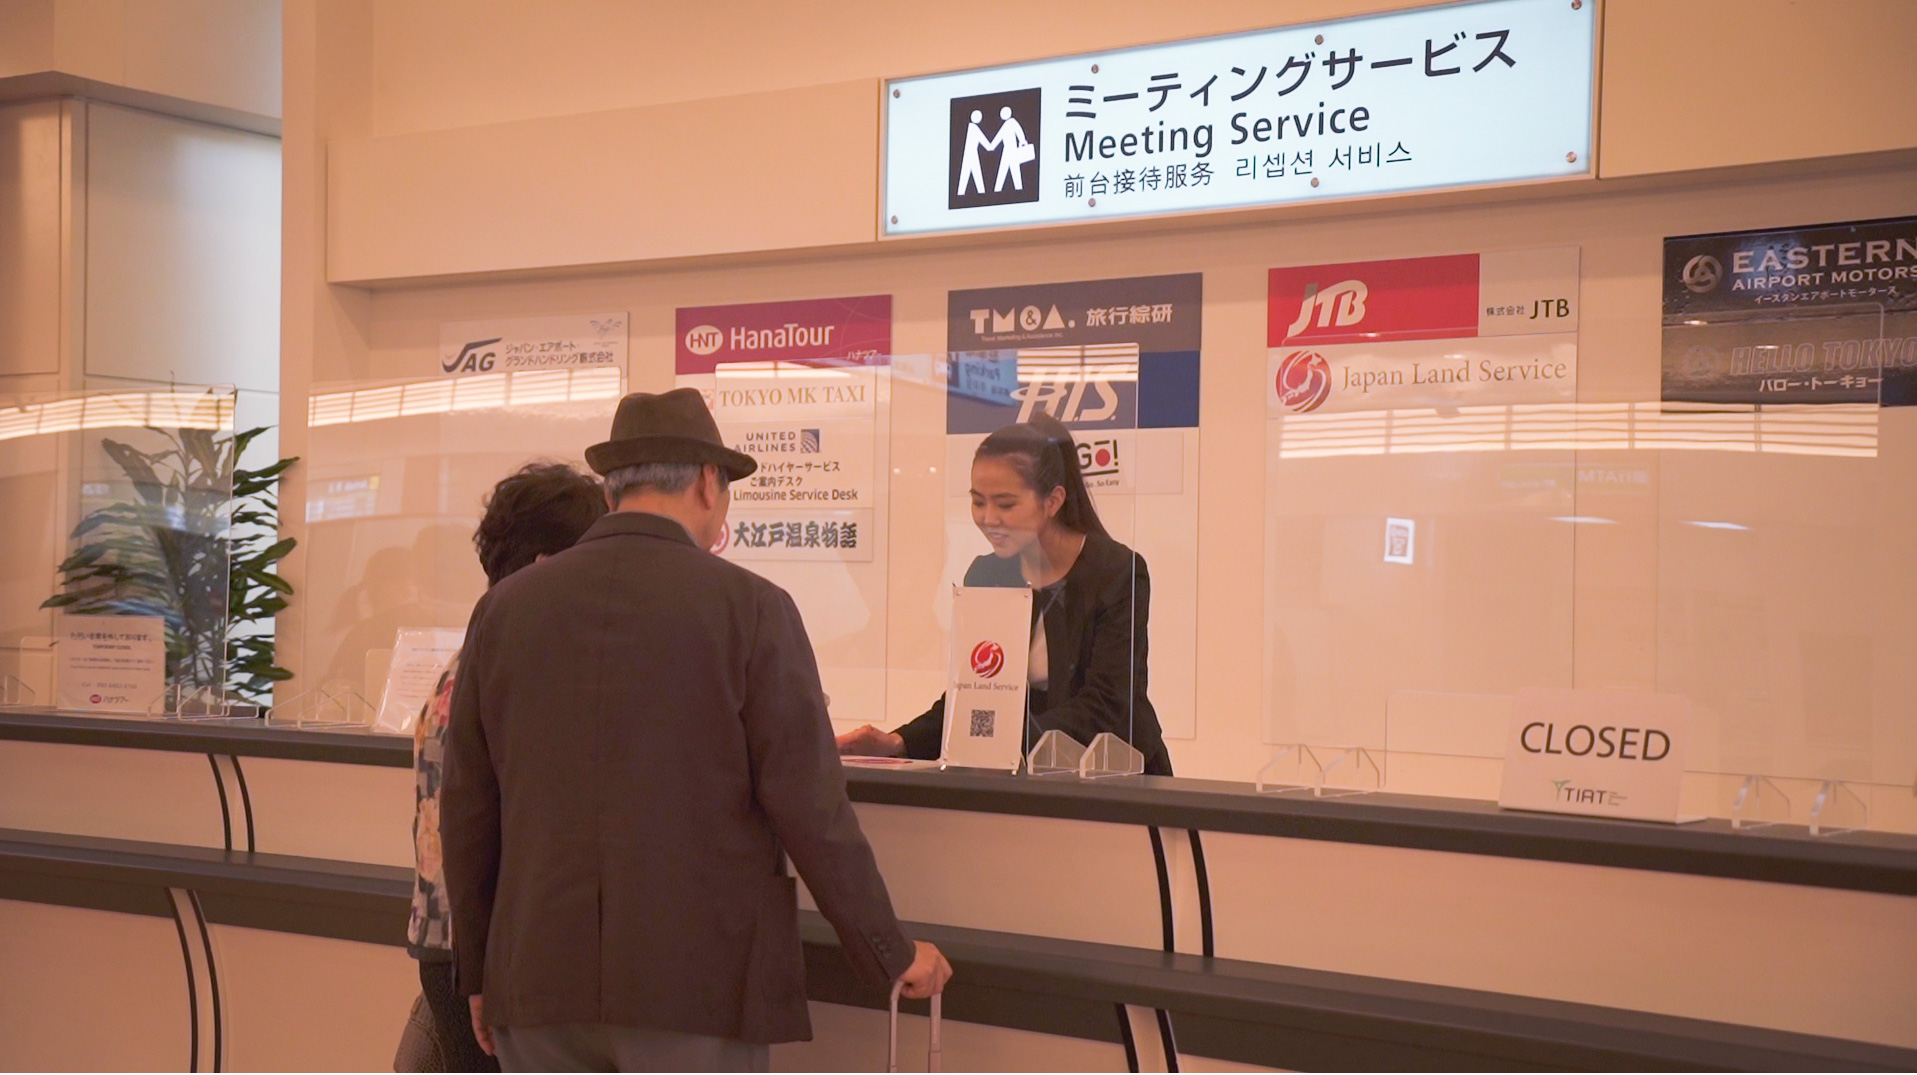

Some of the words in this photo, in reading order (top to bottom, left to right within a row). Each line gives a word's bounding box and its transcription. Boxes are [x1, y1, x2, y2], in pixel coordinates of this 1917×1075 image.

[1066, 29, 1517, 119] ミーティングサービス
[1065, 120, 1214, 163] Meeting
[1230, 101, 1371, 146] Service
[1236, 148, 1314, 180] 리셉션
[1328, 141, 1413, 171] 서비스
[1064, 161, 1214, 199] 前台接待服务
[1732, 239, 1917, 274] EASTERN
[1731, 272, 1825, 292] AIRPORT
[1831, 266, 1917, 284] MOTORS
[1086, 303, 1173, 327] 旅行綜研
[1287, 279, 1368, 337] JTB
[1486, 305, 1525, 317] 株式会社
[1529, 298, 1570, 320] JTB
[690, 331, 719, 348] HNT
[730, 323, 835, 350] HanaTour
[505, 351, 614, 367] グランドハンドリング株式会社
[1729, 343, 1815, 376] HELLO
[1822, 336, 1917, 371] TOKYO
[1342, 364, 1403, 393] Japan
[1412, 360, 1470, 386] Land
[1478, 358, 1567, 383] Service
[719, 388, 782, 407] TOKYO
[787, 387, 817, 405] MK
[823, 385, 866, 403] TAXI
[734, 443, 796, 453] AIRLINES
[746, 432, 796, 441] UNITED
[733, 489, 787, 501] Limousine
[789, 489, 829, 501] Service
[831, 488, 858, 500] Desk
[750, 476, 803, 487] ご案内デスク
[733, 521, 858, 548] 大江戸温泉物語
[974, 682, 992, 690] Land
[993, 682, 1019, 691] Service
[1520, 722, 1670, 761] CLOSED
[1564, 787, 1607, 804] TIAT
